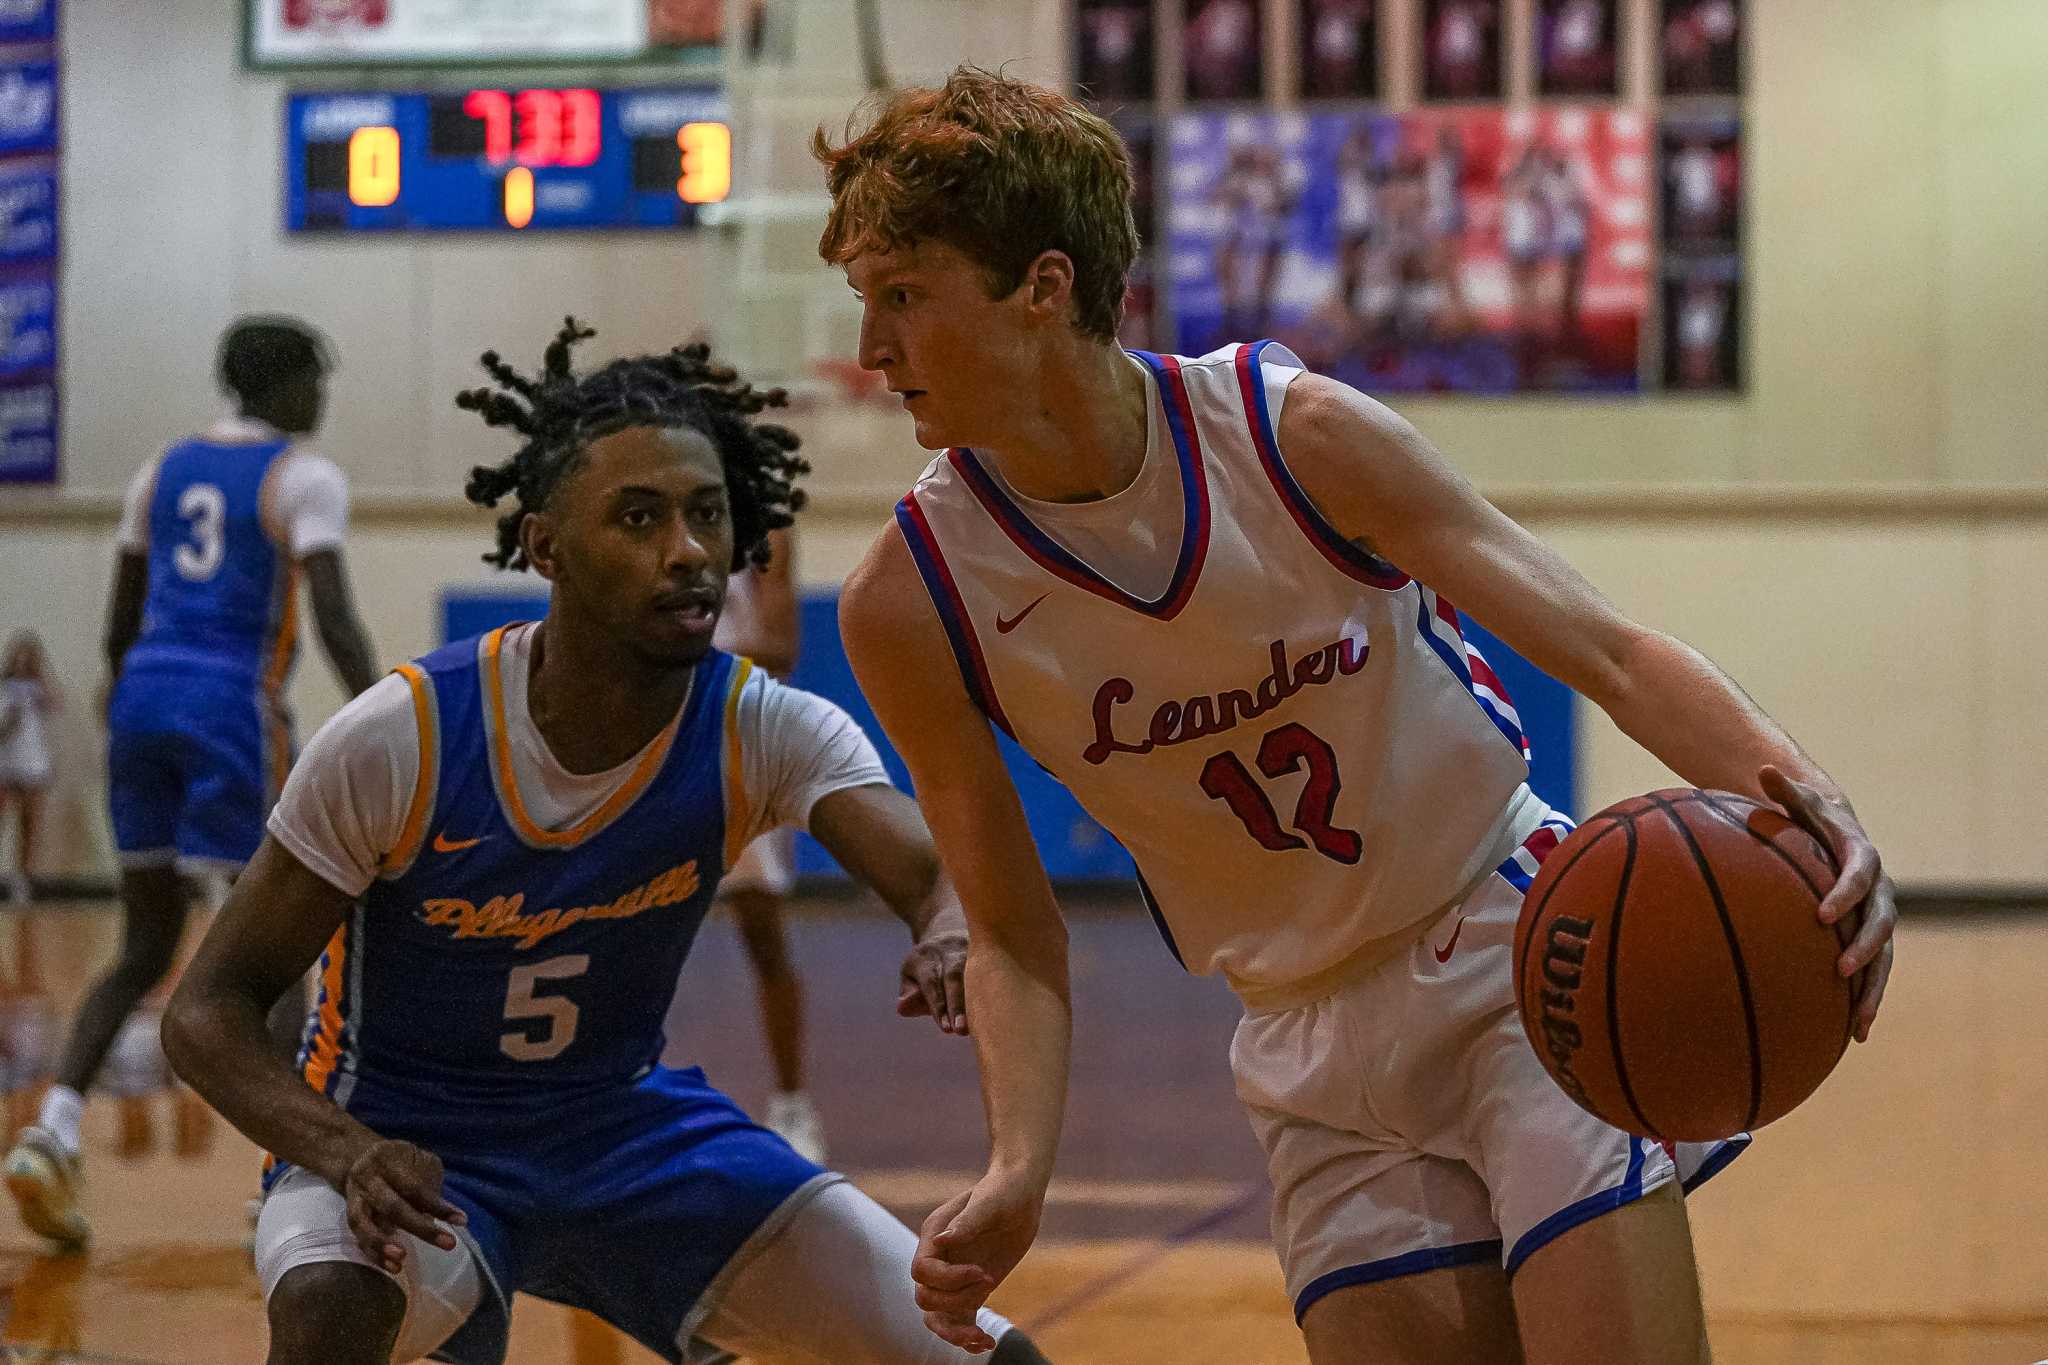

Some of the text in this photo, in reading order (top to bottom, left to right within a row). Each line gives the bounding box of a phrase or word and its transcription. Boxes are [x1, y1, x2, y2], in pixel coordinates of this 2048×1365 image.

[348, 126, 400, 207] 0
[676, 122, 732, 204] 3
[173, 482, 227, 583] 3
[1082, 636, 1370, 765] Leander
[1198, 721, 1364, 866] 12
[500, 953, 591, 1062] 5
